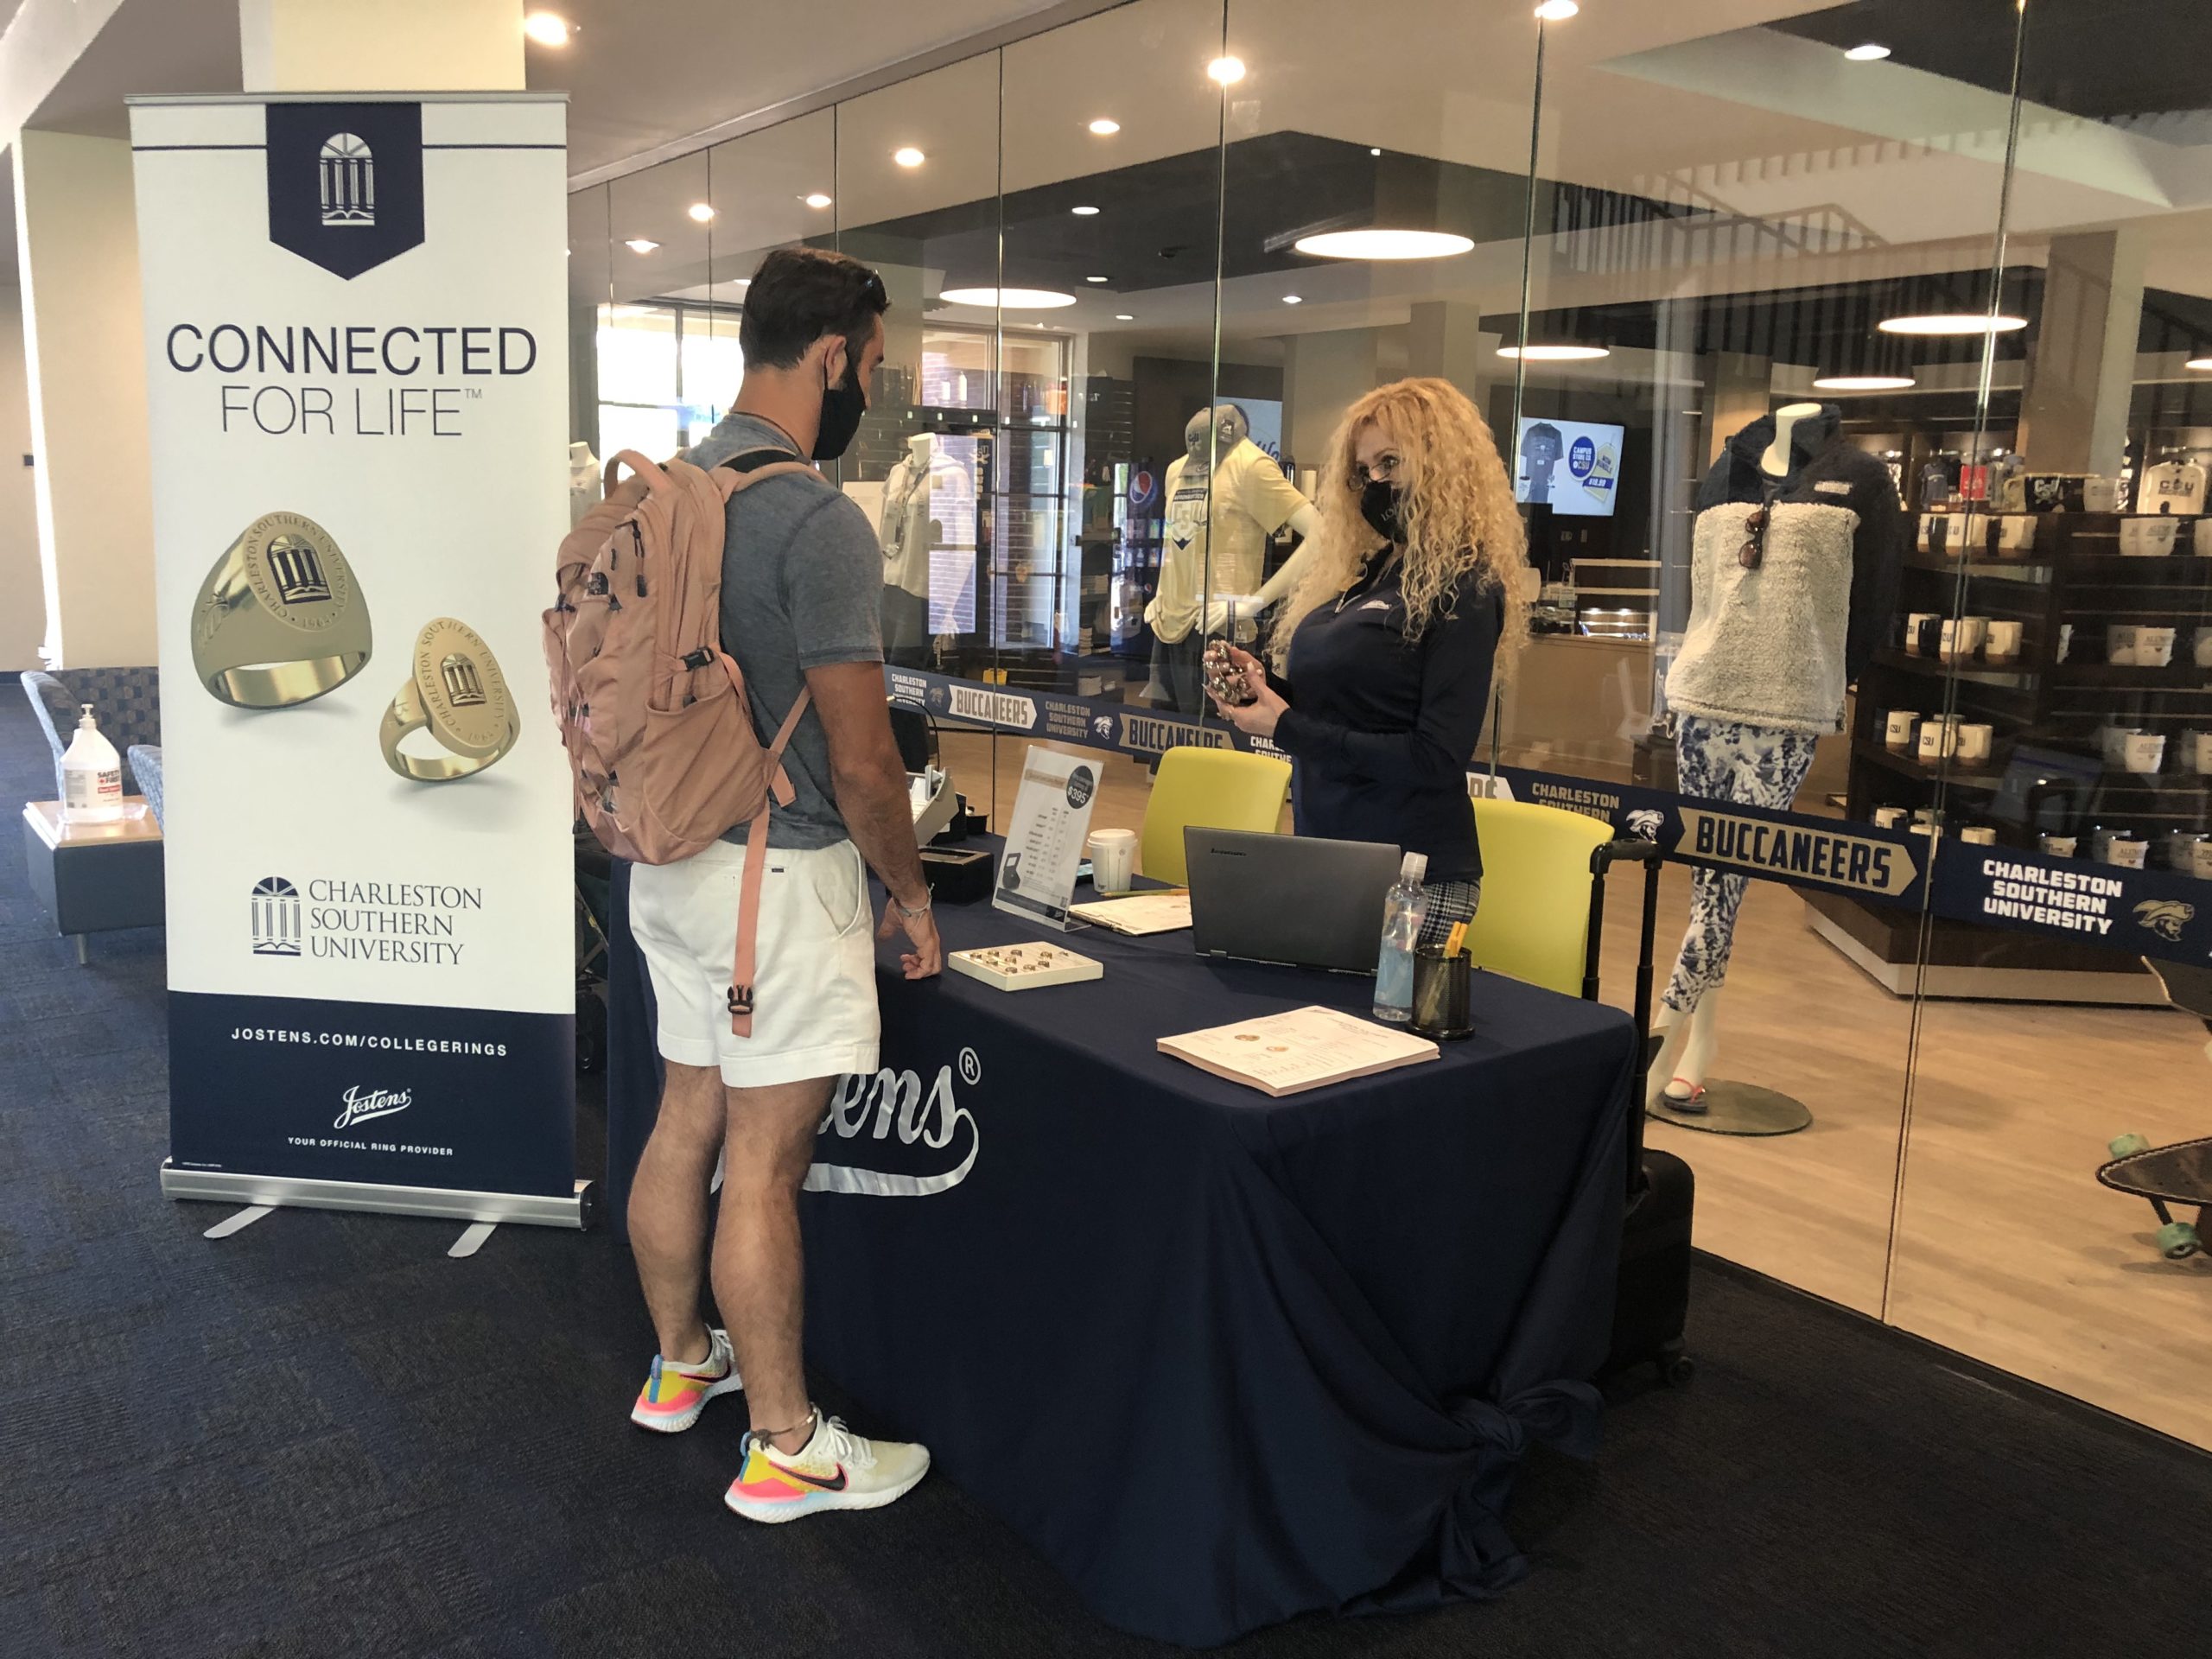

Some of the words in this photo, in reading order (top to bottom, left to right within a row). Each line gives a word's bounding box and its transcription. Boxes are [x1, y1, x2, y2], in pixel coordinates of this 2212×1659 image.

[167, 323, 537, 376] CONNECTED
[221, 385, 334, 435] FOR
[891, 673, 928, 690] CHARLESTON
[894, 683, 925, 699] SOUTHERN
[956, 689, 1029, 727] BUCCANEERS
[1045, 700, 1091, 717] CHARLESTON
[1048, 711, 1087, 728] SOUTHERN
[1046, 722, 1089, 740] UNIVERSITY
[1067, 785, 1087, 804] $395
[1532, 781, 1620, 810] CHARLESTON
[1695, 815, 1892, 889] BUCCANEERS
[1982, 859, 2124, 898] CHARLESTON
[308, 879, 482, 910] CHARLESTON
[1993, 880, 2108, 915] SOUTHERN
[310, 906, 454, 937] SOUTHERN
[1983, 897, 2113, 936] UNIVERSITY
[310, 935, 465, 965] UNIVERSITY
[231, 1027, 508, 1057] JOSTENS.COM/COLLEGERINGS
[288, 1136, 316, 1147] YOUR
[319, 1139, 367, 1151] OFFICIAL
[371, 1142, 397, 1153] RING
[400, 1144, 454, 1157] PROVIDER
